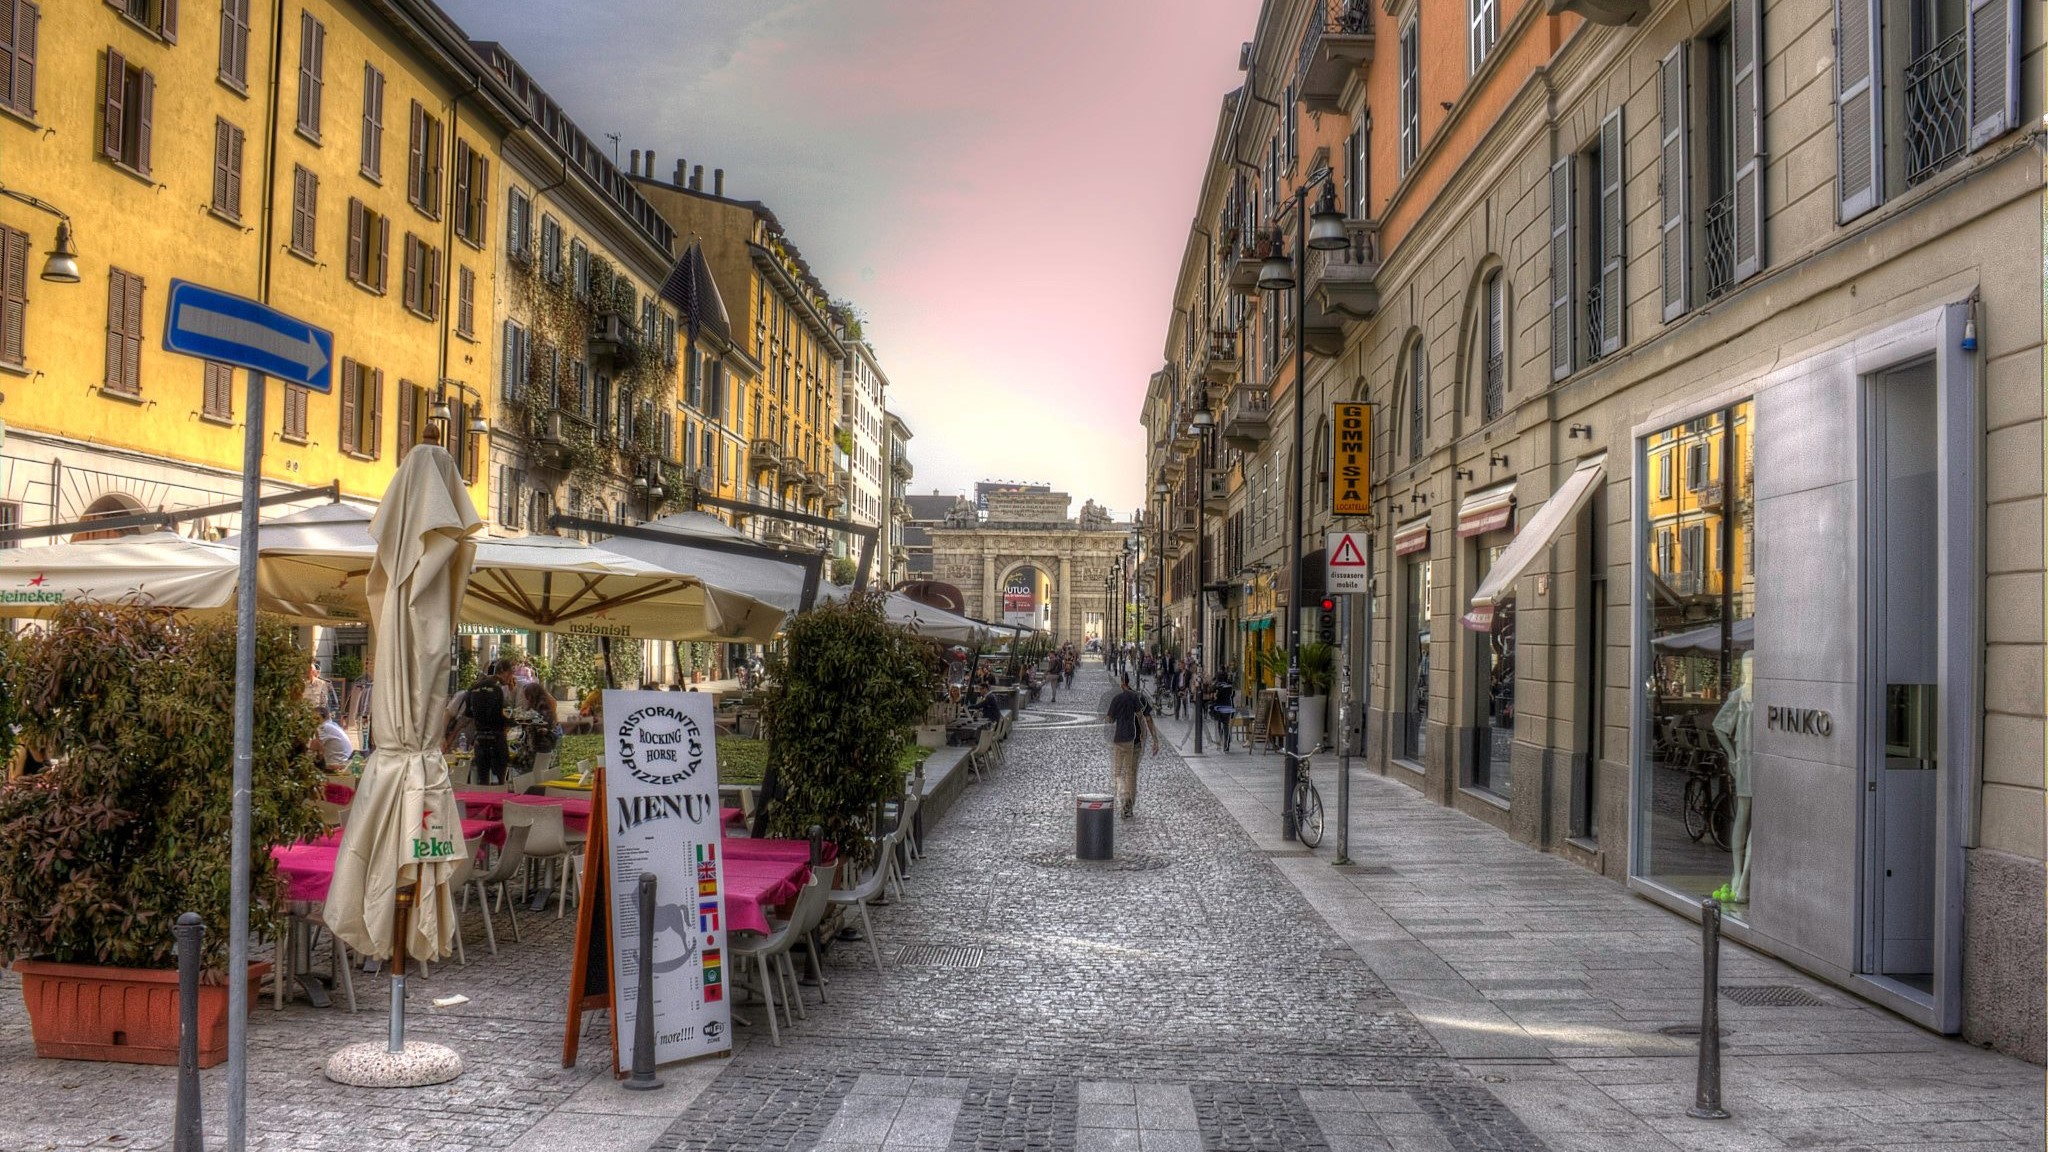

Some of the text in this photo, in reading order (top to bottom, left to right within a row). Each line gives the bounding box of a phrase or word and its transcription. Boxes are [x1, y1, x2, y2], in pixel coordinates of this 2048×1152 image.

[1341, 406, 1363, 501] GOMMISTA
[1336, 503, 1368, 511] LOCATELLI
[1330, 571, 1364, 579] dissuasore
[1336, 581, 1358, 589] mobile
[619, 706, 701, 737] RISTORANTE
[1767, 705, 1833, 737] PINKO
[639, 728, 682, 744] ROCKING
[646, 749, 677, 763] HORSE
[622, 758, 702, 785] PIZZERIA
[616, 793, 711, 837] MENU'
[660, 1026, 694, 1046] more!!!!
